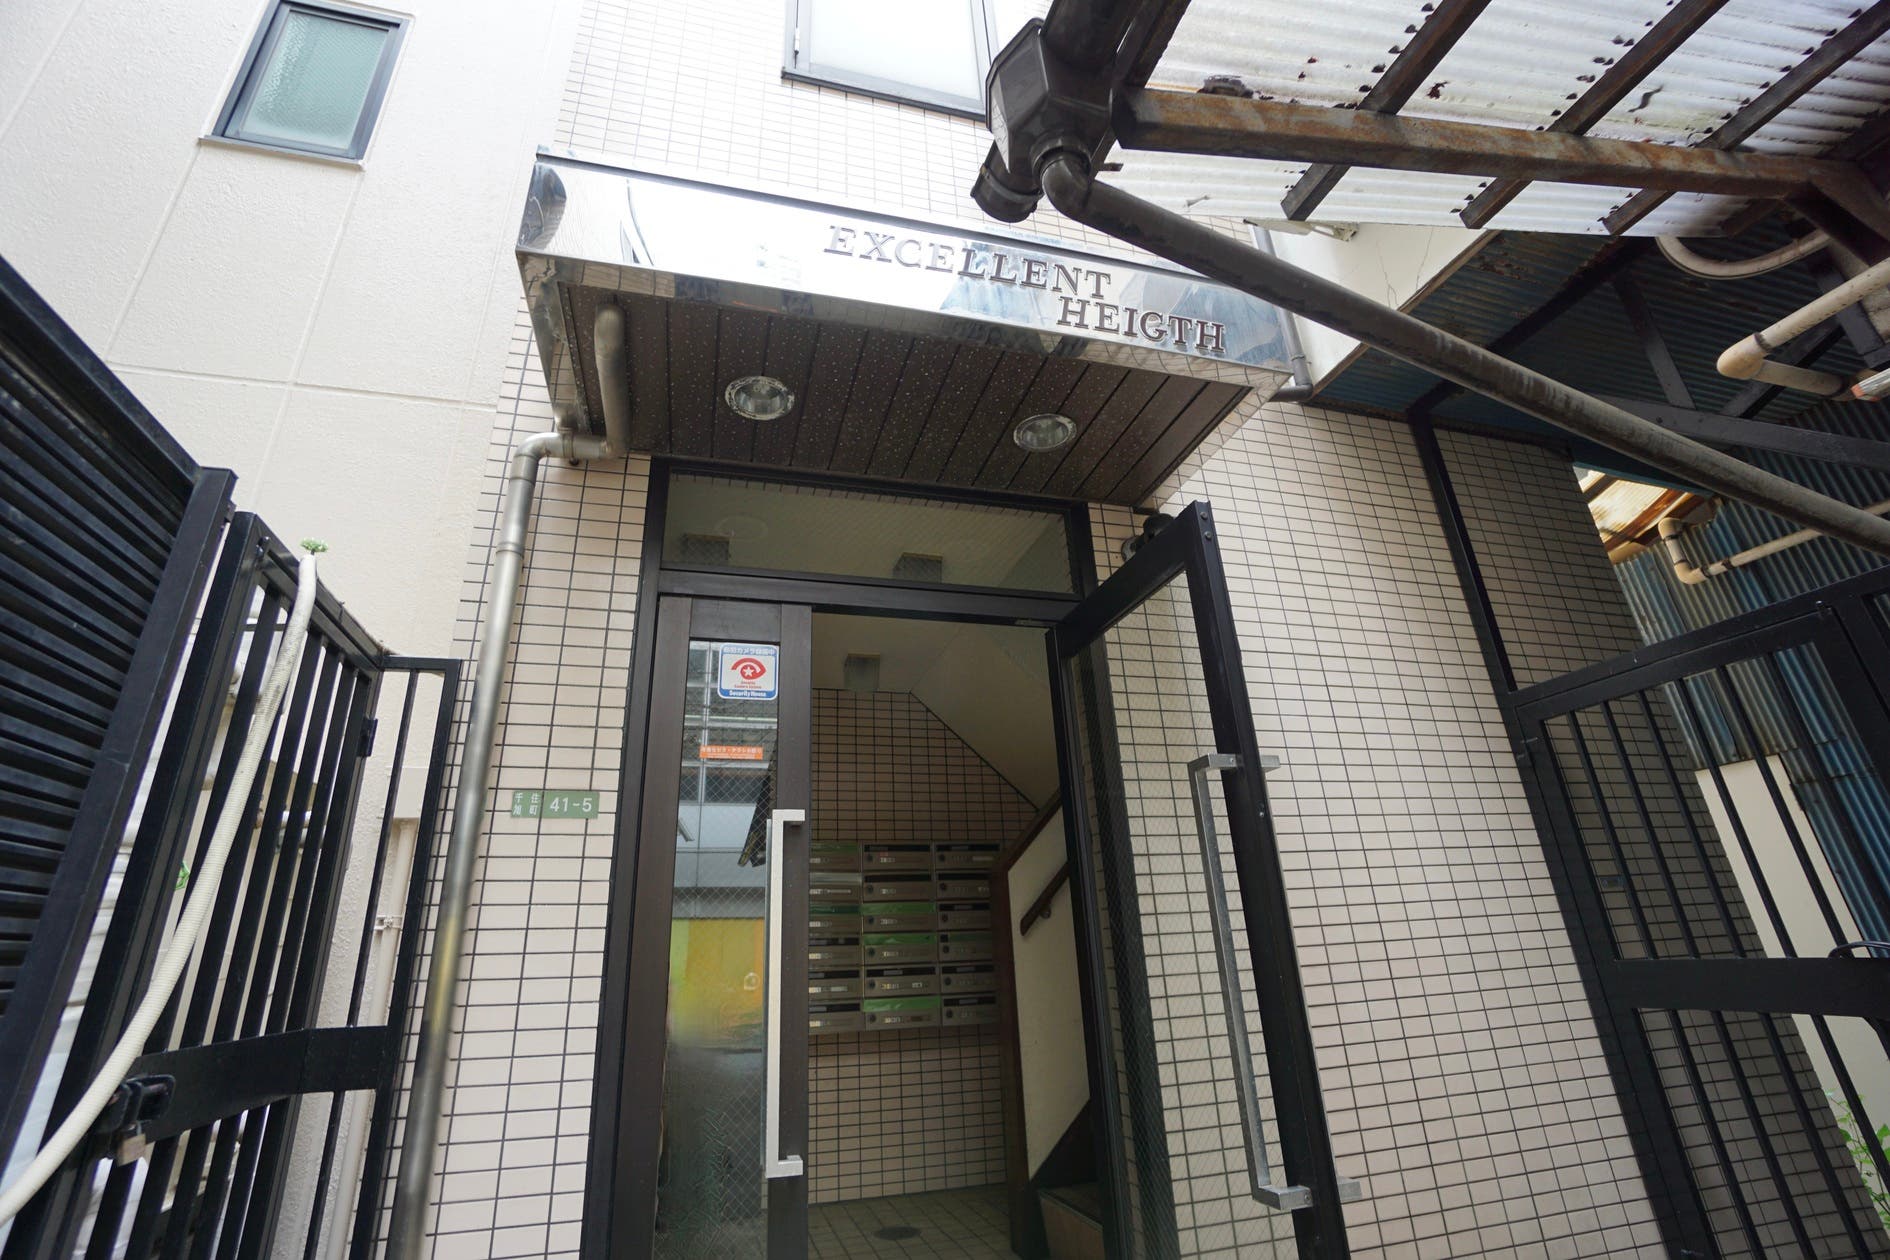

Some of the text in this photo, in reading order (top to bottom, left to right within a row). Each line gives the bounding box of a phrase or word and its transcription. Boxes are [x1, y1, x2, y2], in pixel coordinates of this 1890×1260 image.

[823, 224, 1112, 300] EXCELLENT
[1056, 294, 1227, 353] HEIGTH
[729, 690, 750, 698] Security
[515, 793, 540, 803] 千住
[550, 797, 592, 812] 41-5
